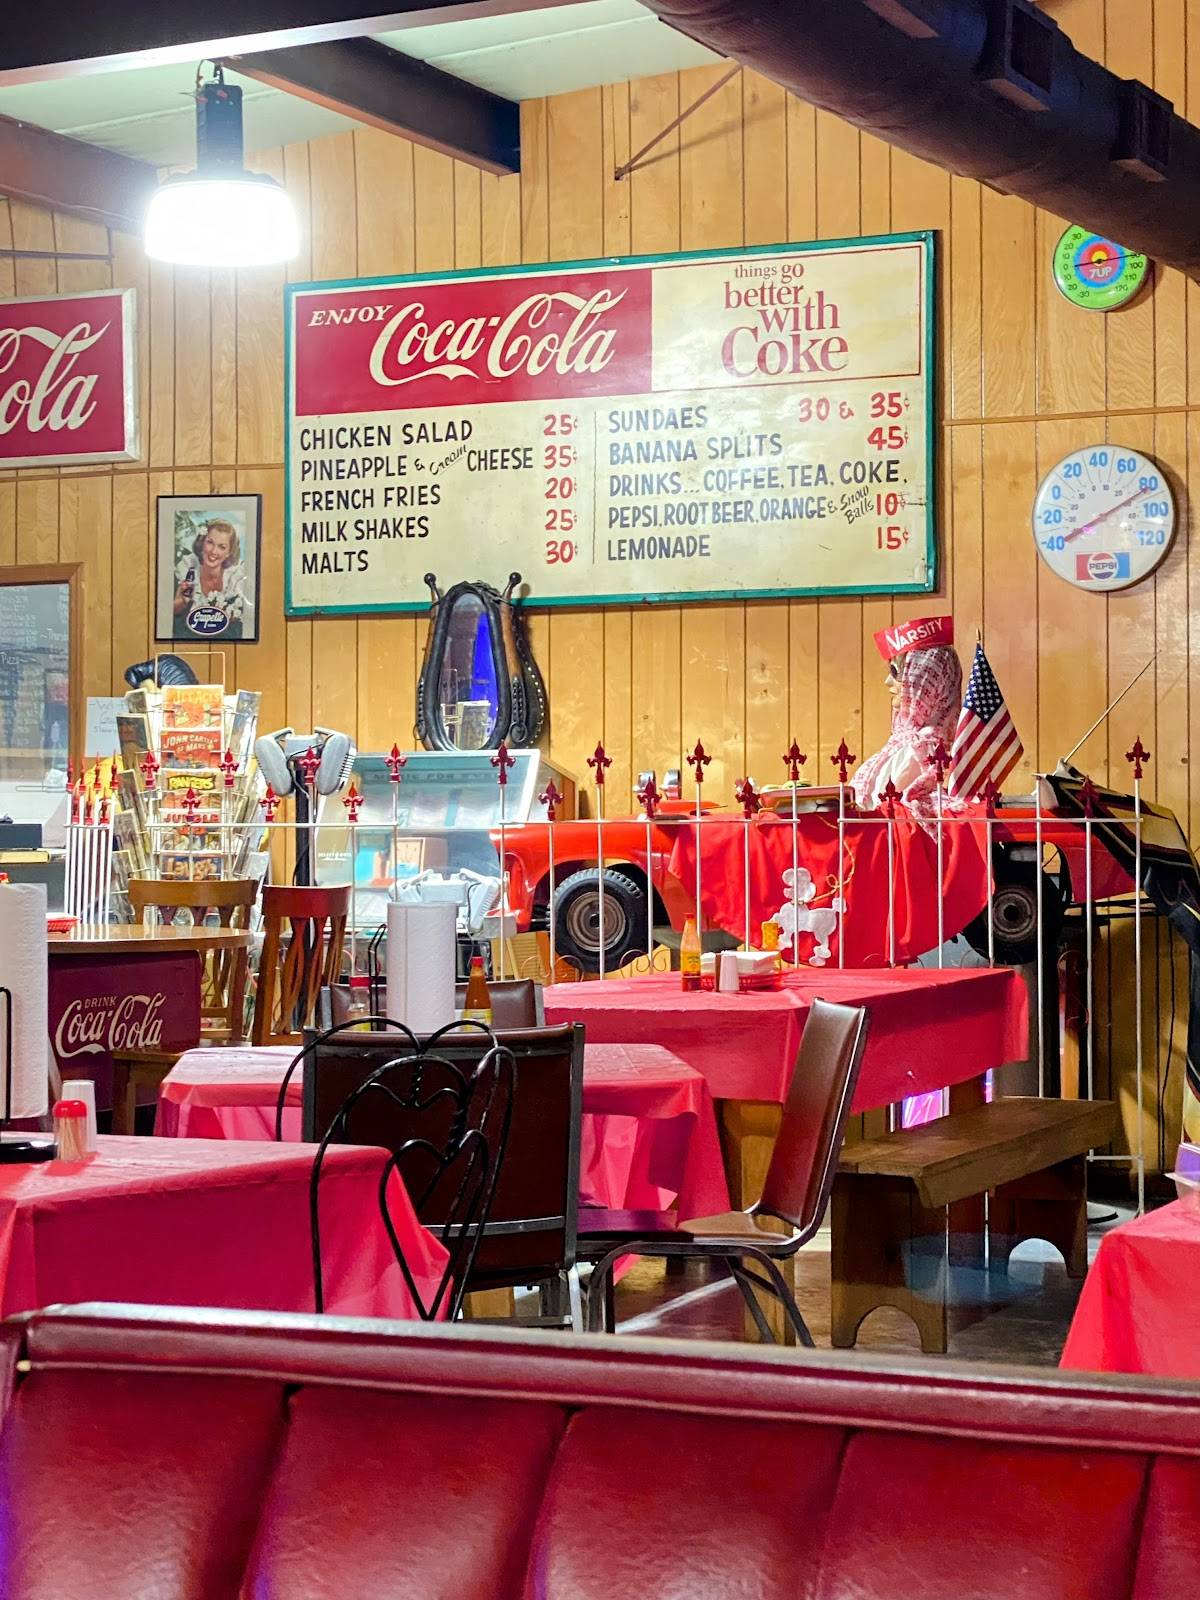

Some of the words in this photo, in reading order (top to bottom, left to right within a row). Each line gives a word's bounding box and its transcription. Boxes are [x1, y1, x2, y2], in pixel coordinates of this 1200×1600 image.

[734, 264, 778, 279] things
[780, 263, 805, 284] go
[1088, 266, 1112, 279] 7UP
[723, 280, 804, 309] better
[307, 304, 395, 327] ENJOY
[756, 290, 840, 334] with
[369, 288, 629, 386] Coca-Cola
[721, 325, 849, 378] Coke
[608, 405, 709, 433] SUNDAES
[798, 397, 831, 422] 30
[300, 425, 392, 451] CHICKEN
[402, 420, 473, 445] SALAD
[609, 439, 698, 466] BANANA
[706, 433, 783, 460] SPLITS
[1090, 452, 1108, 467] 40
[301, 455, 408, 482] PINEAPPLE
[414, 458, 426, 472] &
[429, 444, 468, 477] Cream
[467, 447, 534, 472] CHEESE
[1063, 463, 1082, 478] 20
[1117, 458, 1137, 473] 60
[1052, 485, 1061, 500] 0
[1139, 476, 1158, 491] 80
[301, 488, 375, 513] FRENCH
[383, 484, 441, 508] FRIES
[840, 485, 869, 511] Snow
[1143, 501, 1169, 518] 100
[844, 498, 875, 525] Balls
[301, 520, 348, 544] MILK
[353, 516, 430, 541] SHAKES
[1136, 530, 1165, 546] 120
[607, 534, 711, 561] LEMONADE
[301, 549, 369, 575] MALTS
[1088, 562, 1117, 571] PEPSI
[885, 617, 943, 652] VARSITY
[163, 734, 189, 749] JOHN
[84, 996, 117, 1009] DRINK
[55, 992, 167, 1058] Coca-Cola
